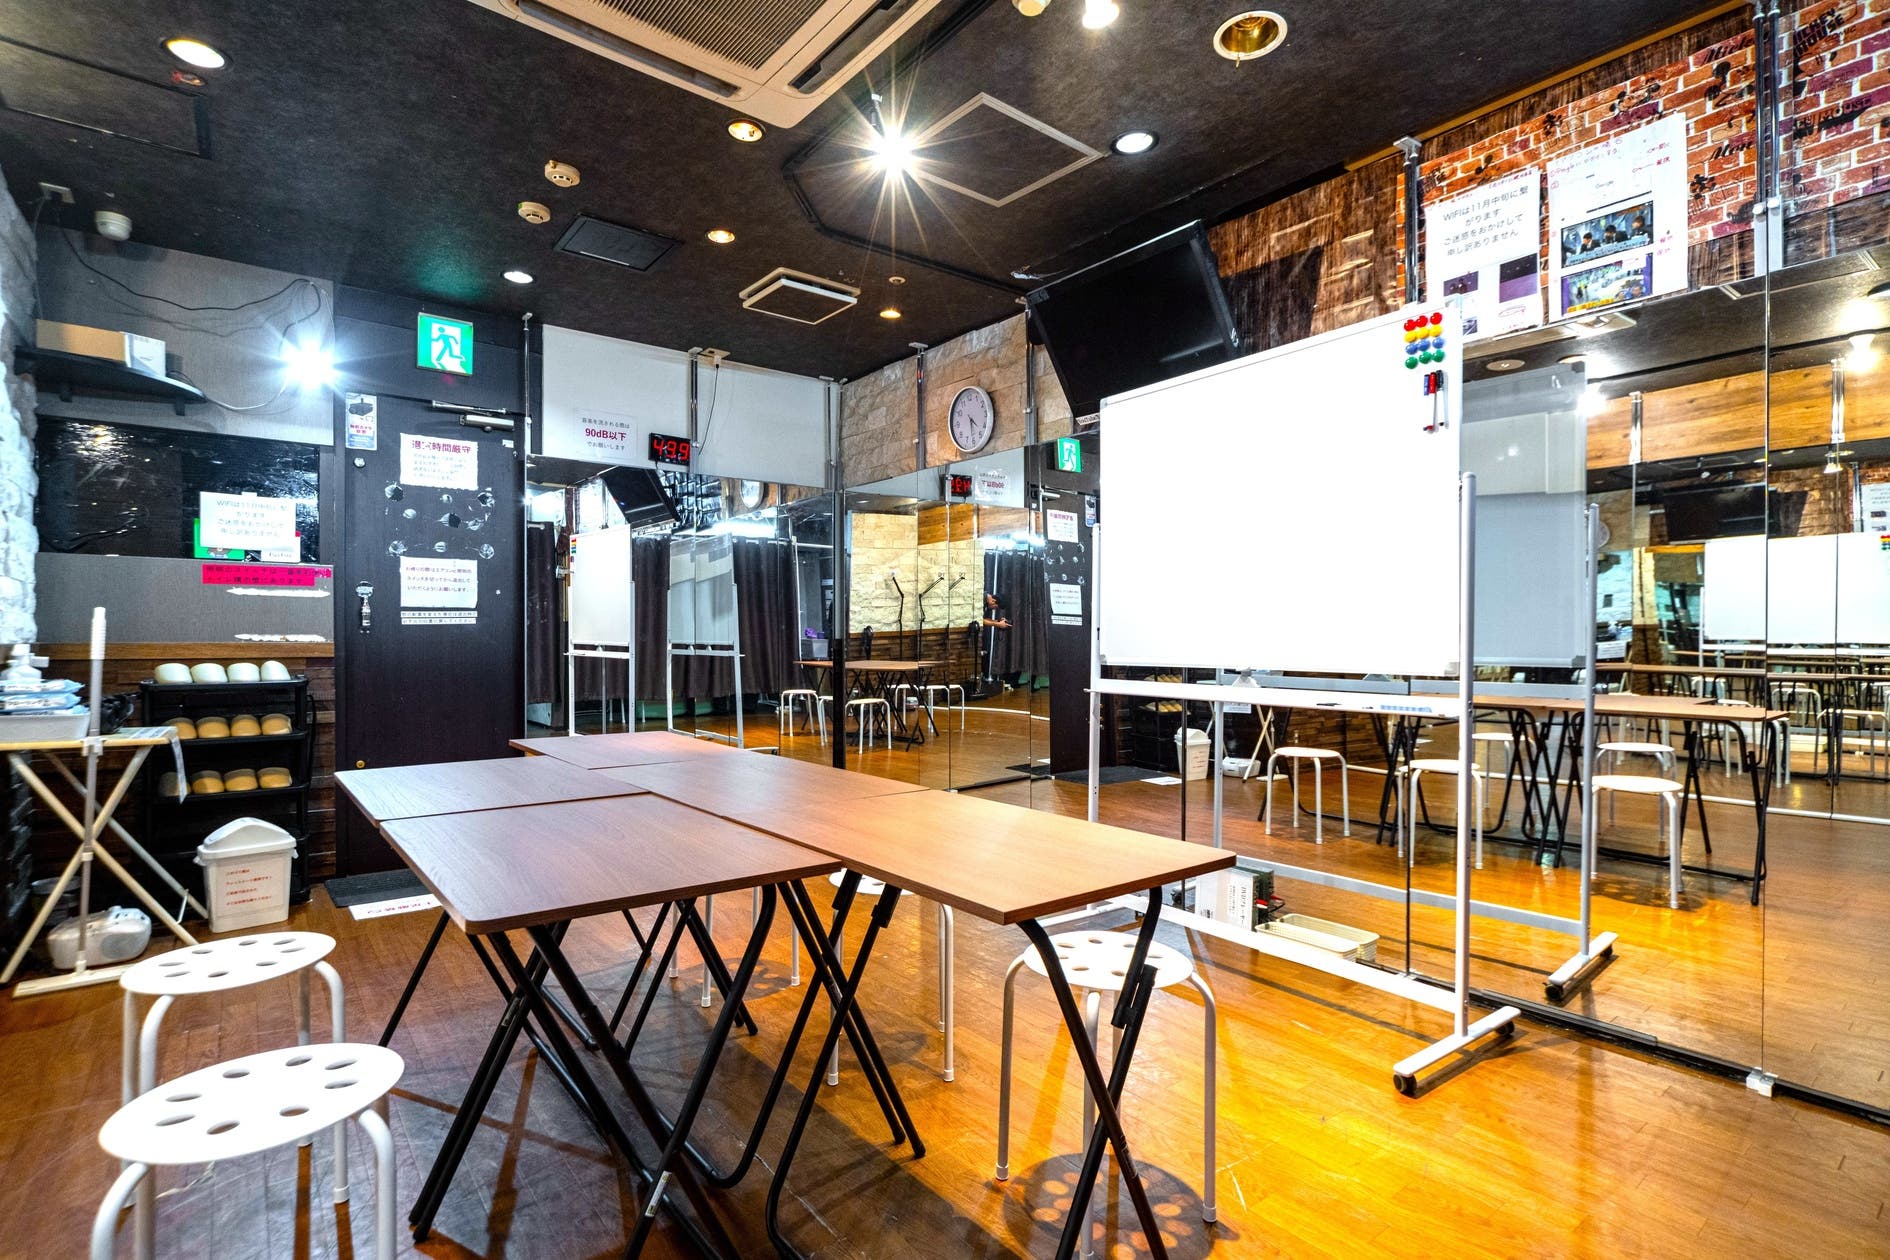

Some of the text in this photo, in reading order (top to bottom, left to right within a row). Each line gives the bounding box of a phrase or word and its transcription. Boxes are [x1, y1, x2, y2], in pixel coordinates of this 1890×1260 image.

[1465, 209, 1500, 227] がります
[1444, 213, 1524, 246] ご迷惑をおかけして
[1447, 230, 1519, 256] 申し訳ありません
[585, 428, 627, 441] 90dB以下
